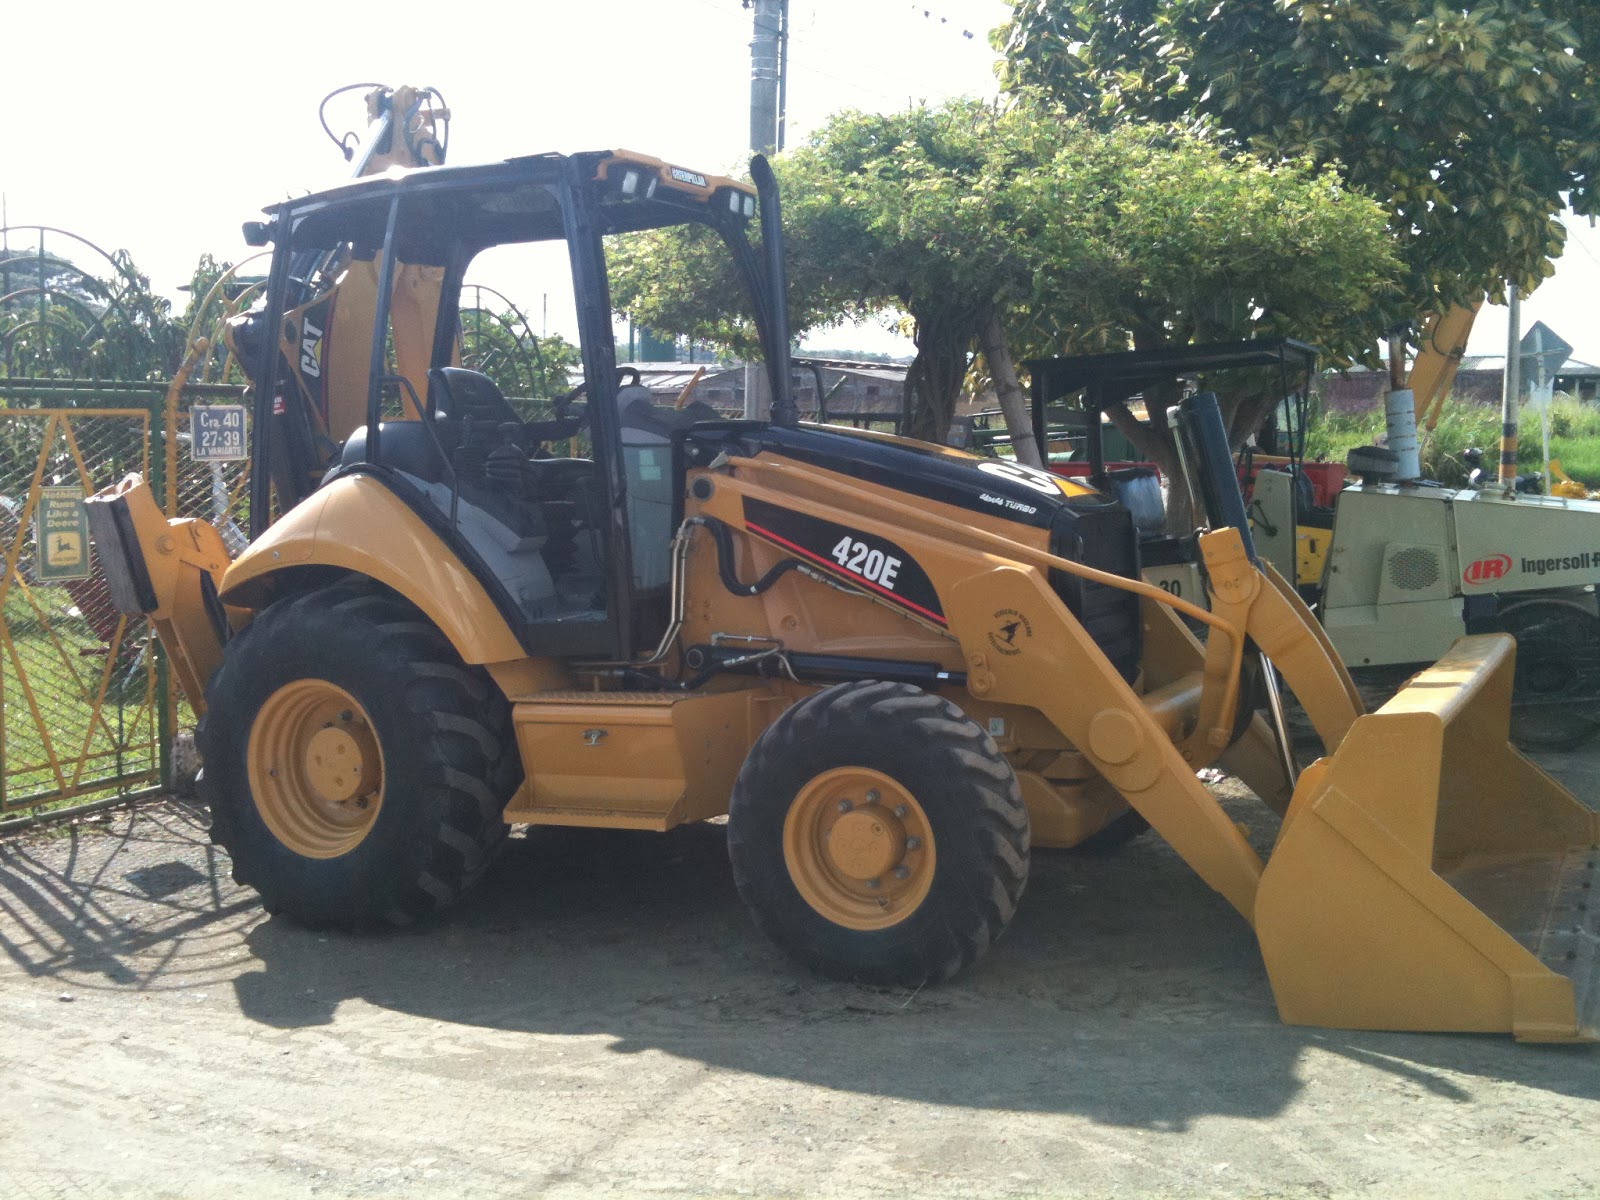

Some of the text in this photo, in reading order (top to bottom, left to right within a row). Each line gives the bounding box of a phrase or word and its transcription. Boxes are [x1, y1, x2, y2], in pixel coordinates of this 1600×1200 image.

[300, 317, 323, 378] CAT
[223, 412, 240, 427] 40
[197, 446, 241, 456] LA VARIANTE
[41, 490, 82, 499] Nothing
[46, 510, 69, 518] Like
[1005, 500, 1037, 515] TURBO
[46, 520, 80, 528] Deere
[831, 535, 902, 590] 420E
[1471, 559, 1504, 580] IR
